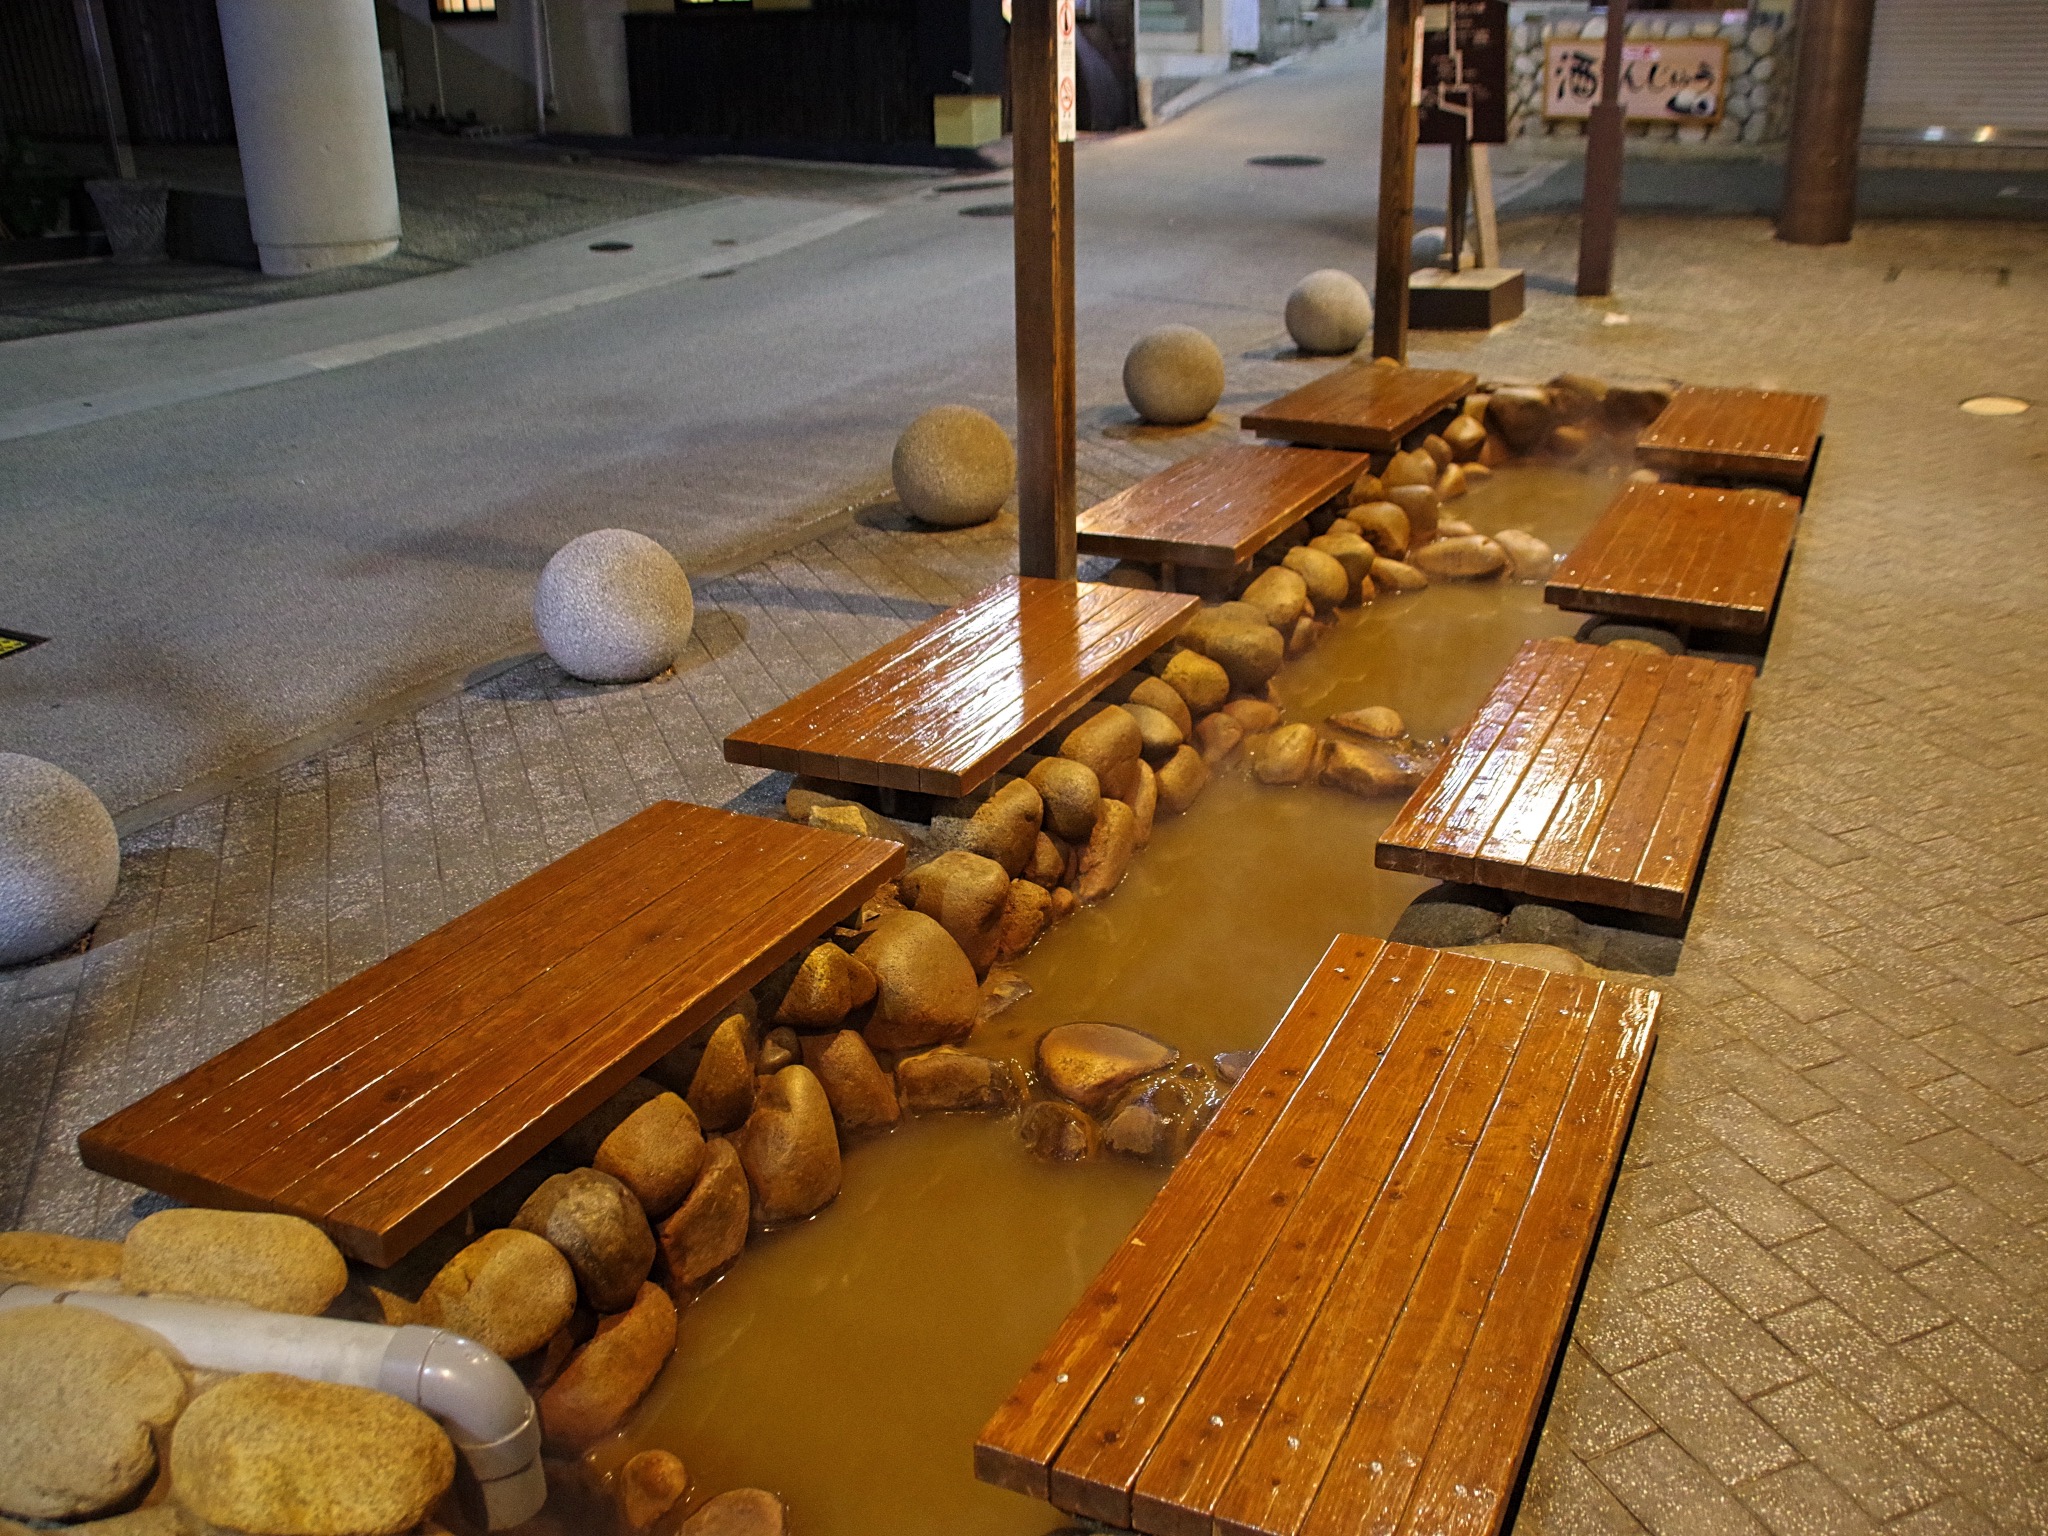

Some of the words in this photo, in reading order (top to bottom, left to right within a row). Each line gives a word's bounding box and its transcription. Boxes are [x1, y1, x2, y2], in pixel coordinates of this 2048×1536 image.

[1556, 52, 1715, 99] 酒んじゅう
